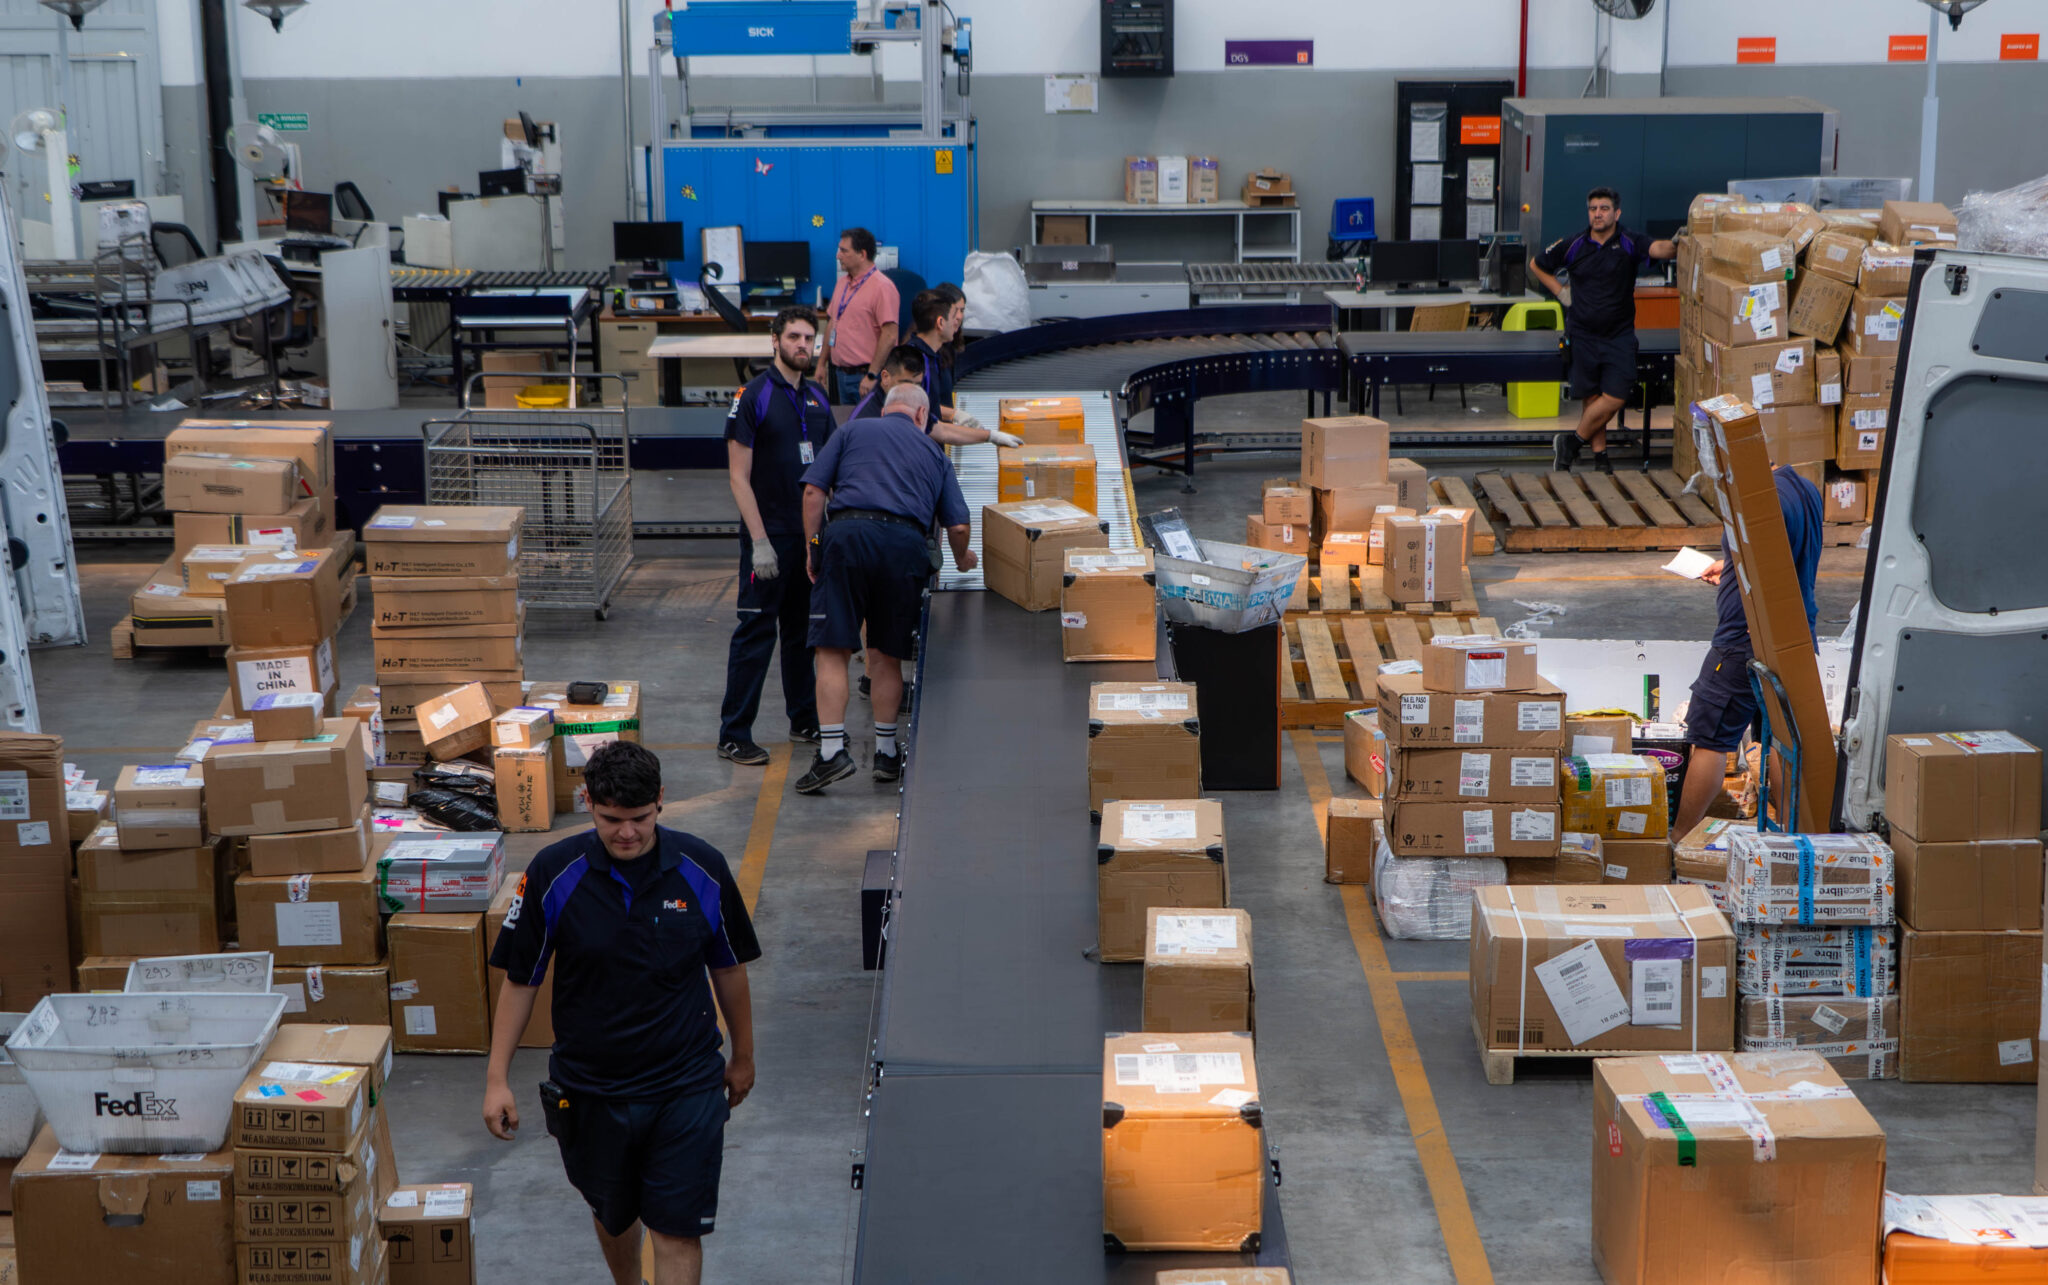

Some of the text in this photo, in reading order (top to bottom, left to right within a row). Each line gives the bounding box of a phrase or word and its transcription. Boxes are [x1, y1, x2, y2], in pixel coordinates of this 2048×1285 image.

[748, 27, 774, 37] SICK
[256, 660, 291, 670] MADE
[269, 671, 282, 680] IN
[256, 680, 296, 691] CHINA
[663, 899, 687, 909] FedEx
[1872, 997, 1881, 1041] uscalibre
[94, 1091, 178, 1117] FedEx
